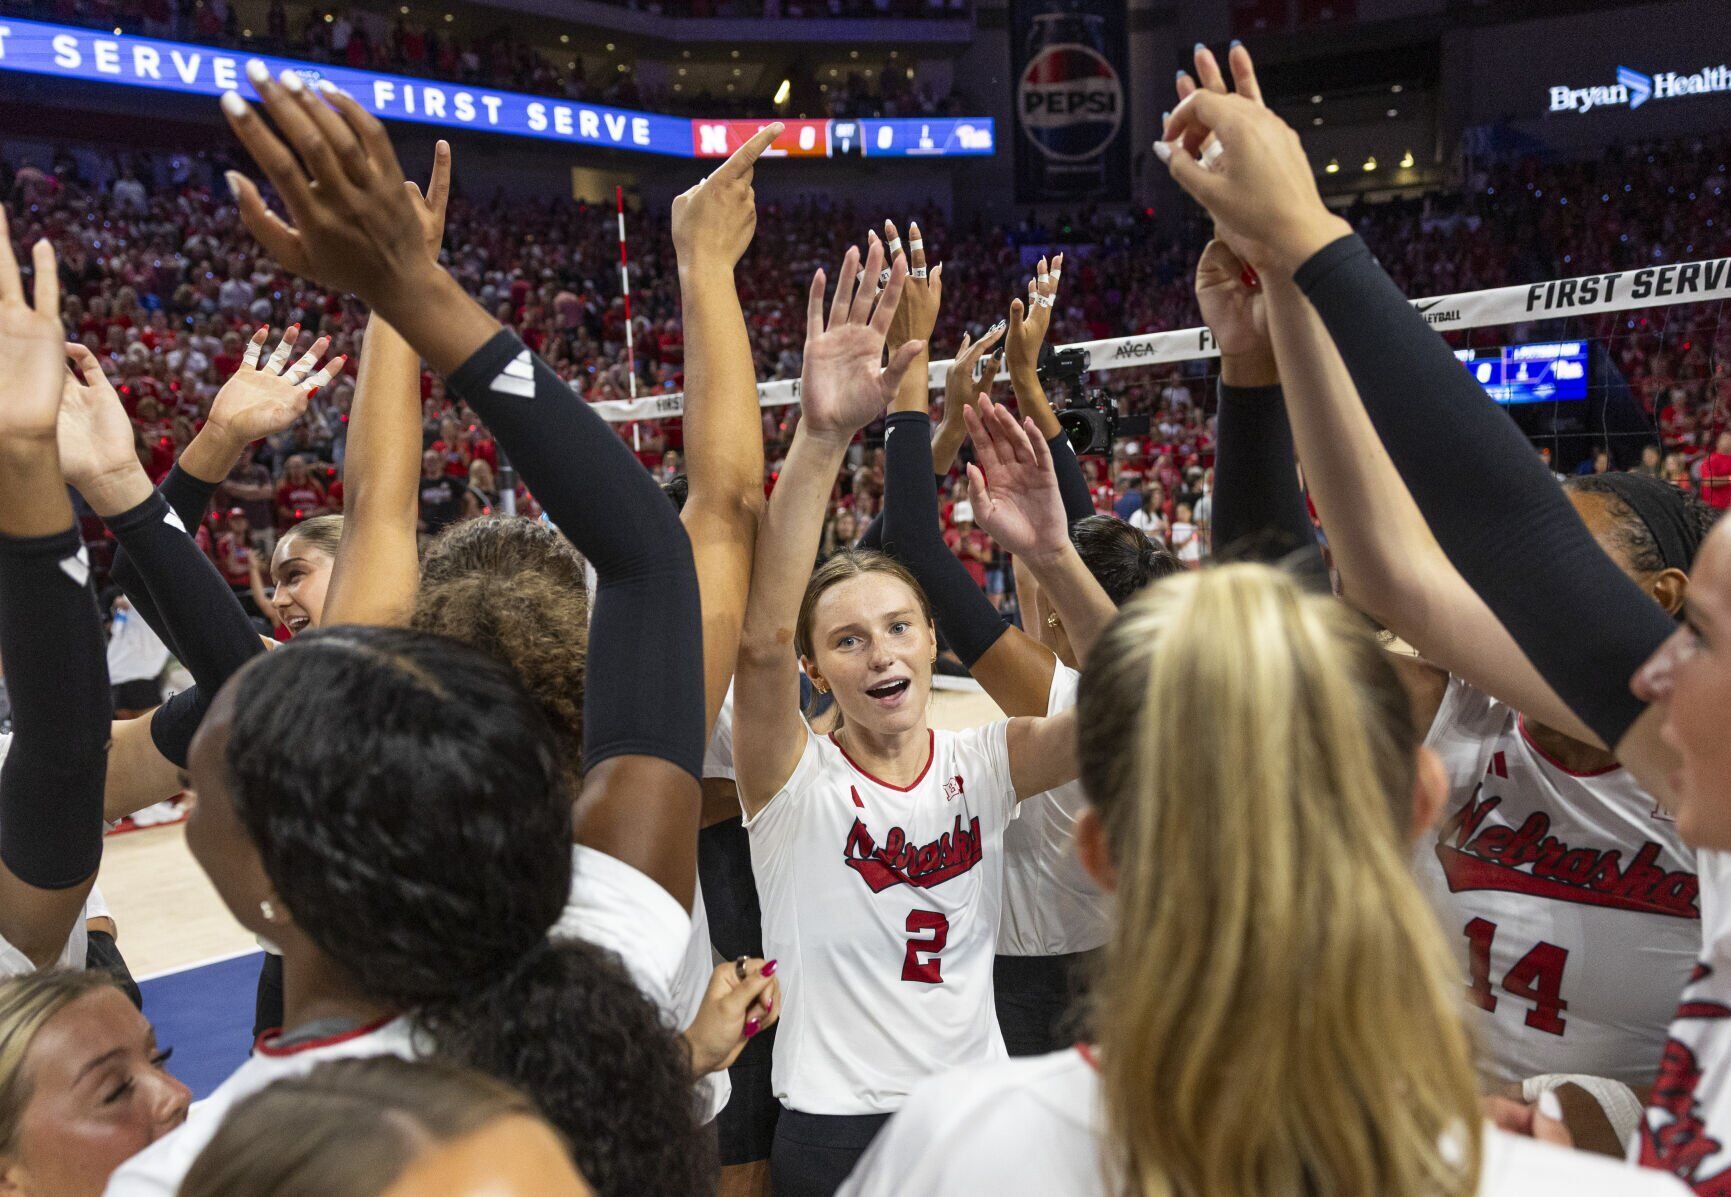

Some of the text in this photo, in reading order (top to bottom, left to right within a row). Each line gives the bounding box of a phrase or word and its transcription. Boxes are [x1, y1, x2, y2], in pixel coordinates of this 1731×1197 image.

[52, 34, 239, 90] SERVE
[1549, 64, 1731, 114] Bryan Health
[373, 80, 651, 146] FIRST SERVE
[1024, 92, 1116, 114] PEPSI
[1526, 259, 1731, 313] FIRST SERV
[1115, 341, 1156, 359] AVCA
[656, 396, 684, 412] FIRS
[1436, 783, 1700, 918] Nebraska
[901, 908, 950, 984] 2
[1463, 916, 1569, 1037] 14
